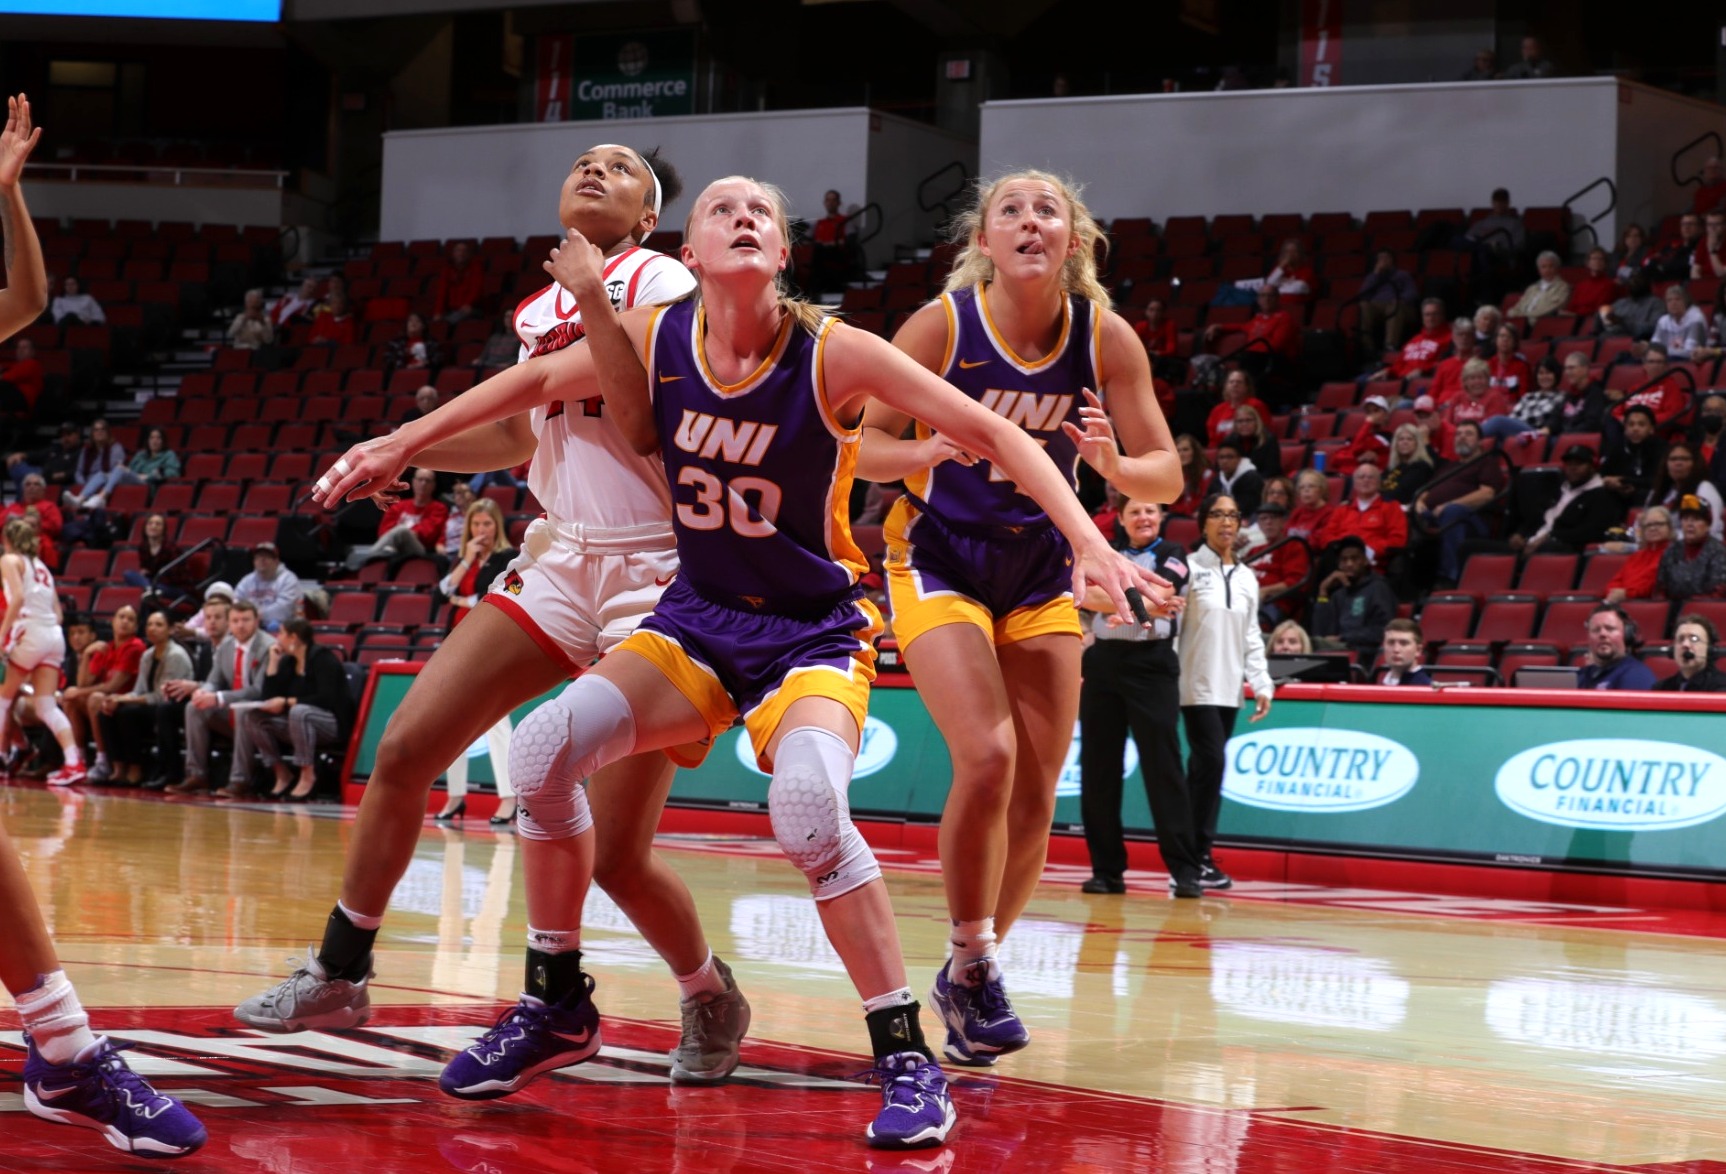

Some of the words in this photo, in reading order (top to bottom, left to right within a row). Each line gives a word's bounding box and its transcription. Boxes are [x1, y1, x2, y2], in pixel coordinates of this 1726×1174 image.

[577, 79, 687, 102] Commerce
[602, 100, 654, 120] Bank
[673, 408, 779, 467] UNI
[676, 465, 783, 538] 30
[1234, 741, 1393, 781] COUNTRY
[1529, 753, 1712, 797] COUNTRY
[1255, 779, 1353, 799] FINANCIAL
[1554, 794, 1667, 816] FINANCIAL
